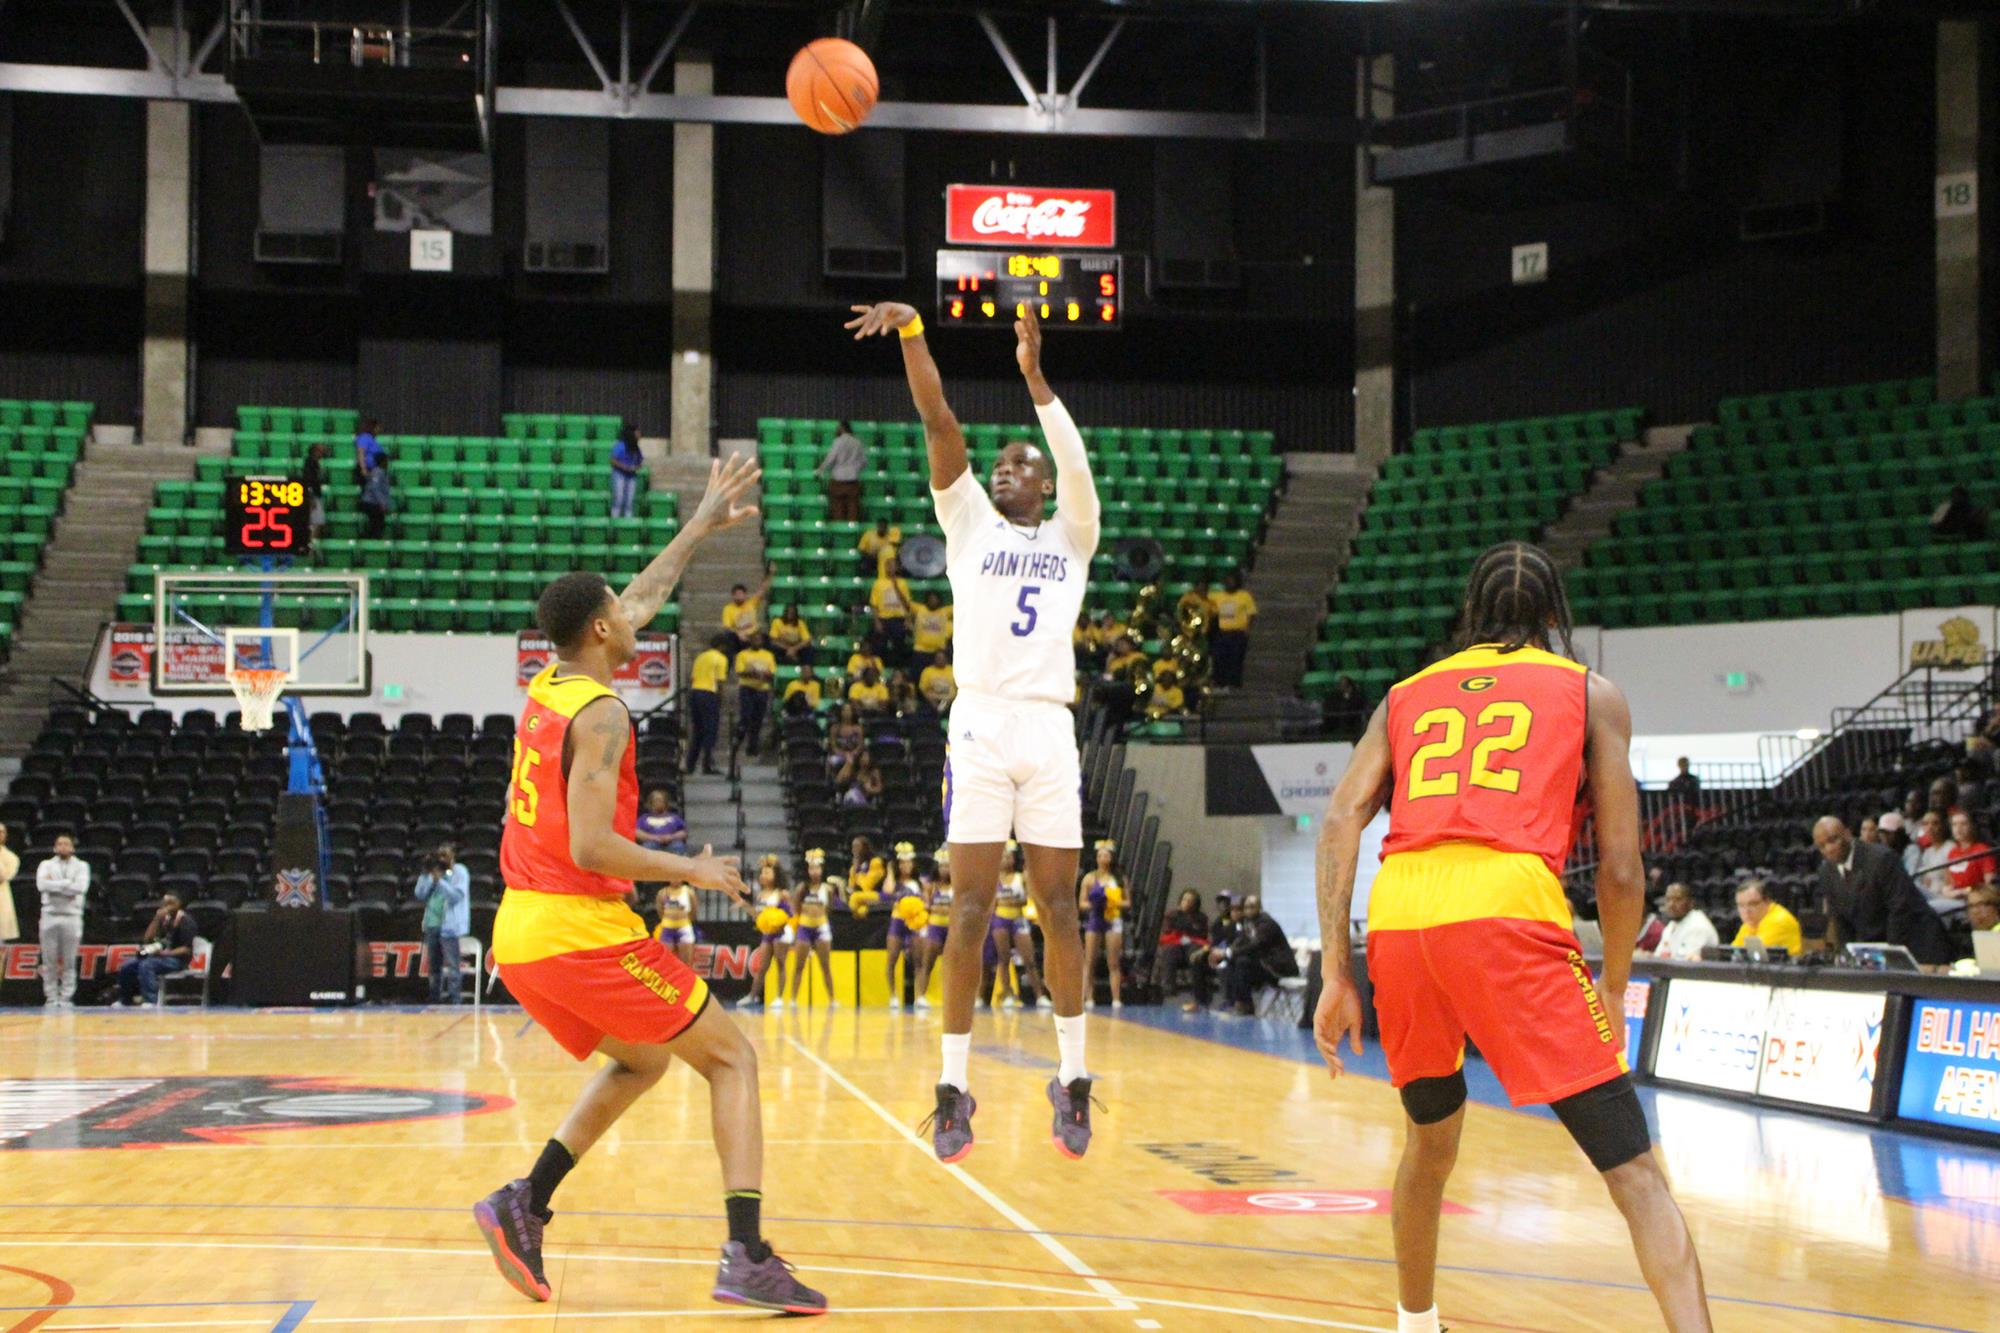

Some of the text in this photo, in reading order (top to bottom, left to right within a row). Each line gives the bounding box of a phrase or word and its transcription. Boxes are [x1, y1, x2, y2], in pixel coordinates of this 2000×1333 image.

[1943, 182, 1971, 207] 18
[972, 196, 1092, 239] Coca-Cola
[419, 239, 446, 261] 15
[1519, 251, 1540, 274] 17
[240, 481, 304, 507] 13:48
[241, 507, 293, 548] 25
[981, 550, 1068, 582] PANTHERS
[1010, 586, 1041, 637] 5
[1458, 675, 1498, 693] G
[1408, 700, 1534, 803] 22
[619, 951, 682, 1006] GRAMBLING
[1917, 1006, 1966, 1057] BILL
